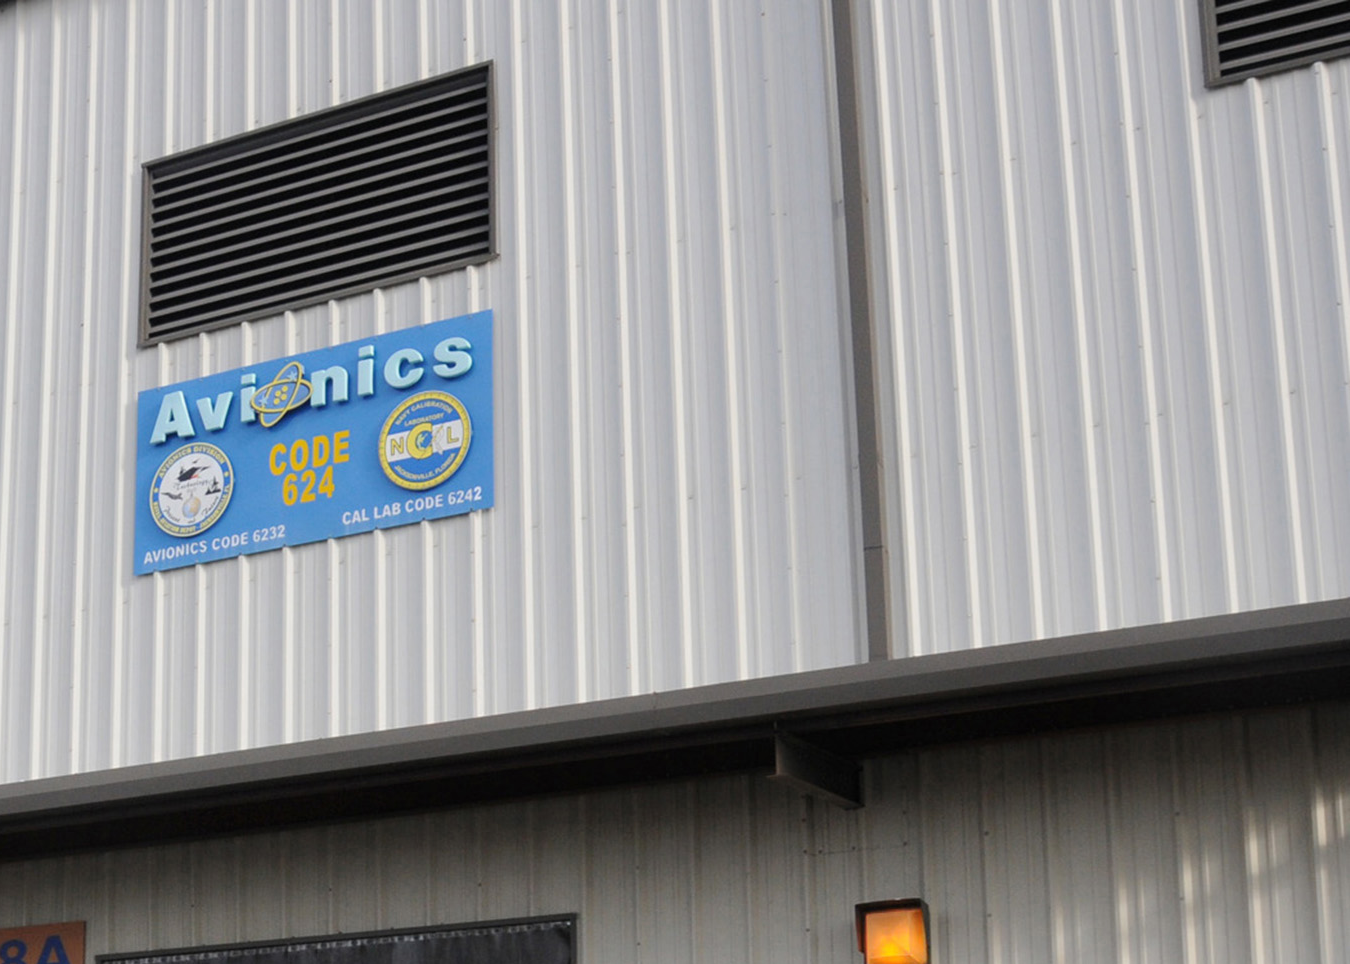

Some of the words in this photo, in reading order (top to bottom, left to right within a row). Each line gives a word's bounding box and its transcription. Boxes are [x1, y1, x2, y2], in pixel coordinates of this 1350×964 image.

[269, 430, 350, 476] CODE
[282, 465, 335, 506] 624
[342, 508, 369, 525] CAL
[373, 502, 401, 519] LAB
[405, 494, 443, 513] CODE
[448, 486, 482, 505] 6242
[143, 540, 207, 565] AVIONICS
[211, 532, 248, 550] CODE
[252, 524, 286, 543] 6232
